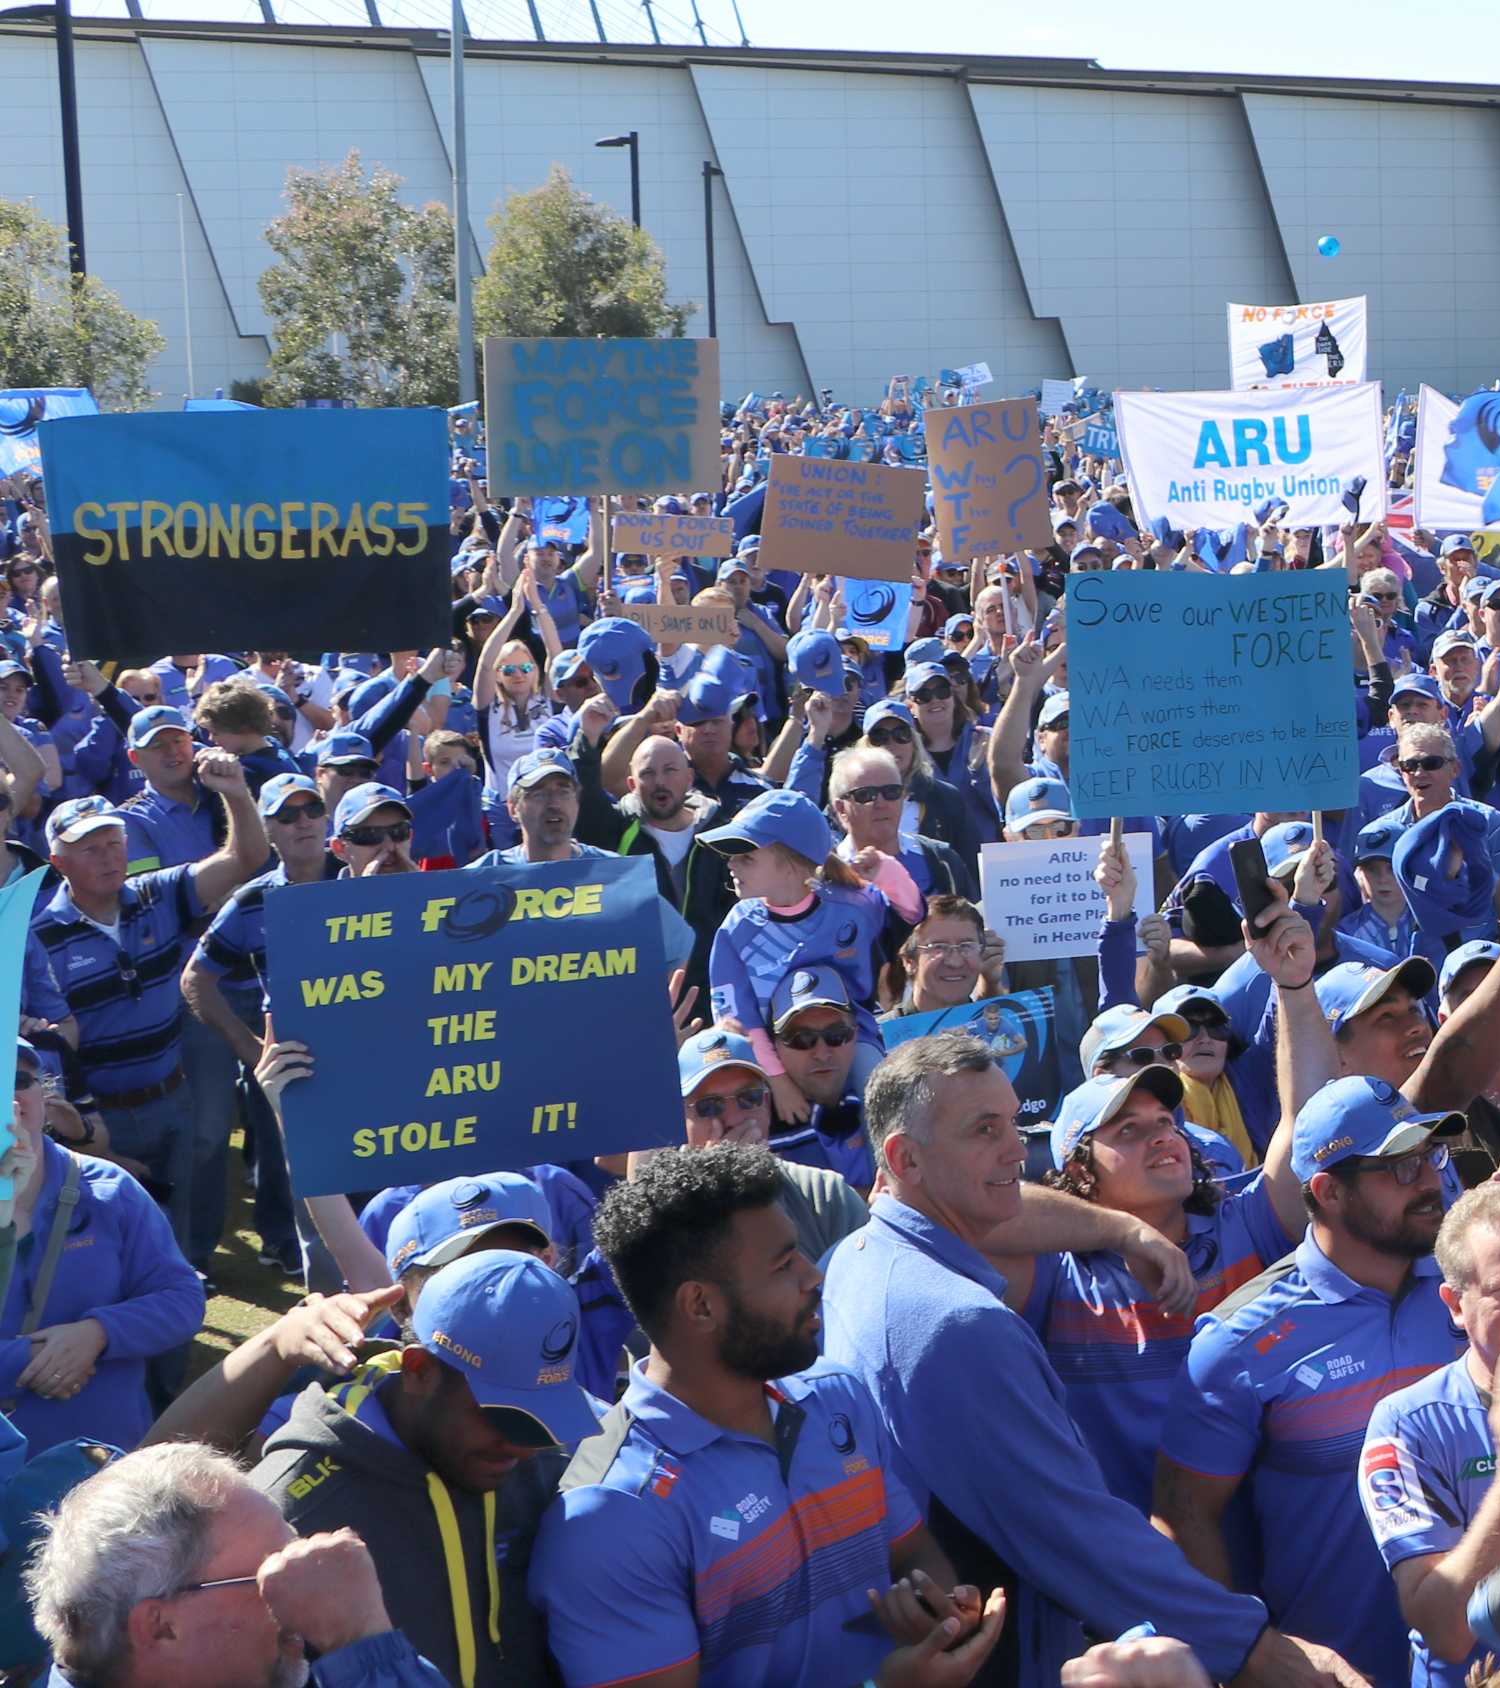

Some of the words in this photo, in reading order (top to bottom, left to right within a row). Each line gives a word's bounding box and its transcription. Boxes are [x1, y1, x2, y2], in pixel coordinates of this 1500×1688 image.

[1242, 307, 1267, 322] NO
[1193, 414, 1312, 469] ARU
[610, 430, 691, 489] ON
[1168, 480, 1206, 503] Anti
[1213, 477, 1275, 506] Rugby
[1283, 474, 1341, 497] Union
[74, 501, 428, 565] STRONGERAS5
[1074, 577, 1162, 626] Save
[1182, 604, 1222, 626] our
[1228, 591, 1350, 625] WESTERN
[1232, 629, 1336, 667] FORCE
[1078, 665, 1131, 695] WA
[1141, 671, 1194, 691] needs
[1202, 669, 1242, 688] them
[1081, 701, 1133, 728] WA
[1141, 705, 1195, 725] wants
[1201, 697, 1240, 715] them
[1074, 737, 1113, 757] The
[1128, 731, 1181, 752] FORCE
[1193, 727, 1264, 748] deserves
[1272, 726, 1287, 742] to
[1289, 721, 1307, 737] be
[1316, 714, 1349, 733] here
[1075, 767, 1137, 800] KEEP
[1152, 761, 1225, 792] RUGBY
[1239, 759, 1263, 785] IN
[1049, 851, 1088, 864] ARU:
[1000, 877, 1019, 887] no
[1024, 873, 1061, 885] need
[1066, 872, 1081, 883] to
[1030, 893, 1053, 905] for
[1056, 892, 1067, 903] it
[1072, 891, 1087, 902] to
[326, 911, 392, 943] THE
[1005, 915, 1033, 927] The
[1038, 911, 1081, 924] Game
[1033, 932, 1047, 943] in
[301, 970, 385, 1007] WAS
[433, 961, 493, 994] MY
[511, 947, 637, 986] DREAM
[427, 1011, 496, 1046] THE
[425, 1061, 500, 1097] ARU
[352, 1116, 478, 1158] STOLE
[531, 1103, 577, 1134] IT!
[431, 1330, 482, 1369] BELONG
[1326, 1354, 1353, 1370] ROAD
[1329, 1360, 1366, 1380] SAFETY
[286, 1456, 343, 1500] BLK
[736, 1493, 758, 1514] ROAD
[743, 1496, 773, 1523] SAFETY
